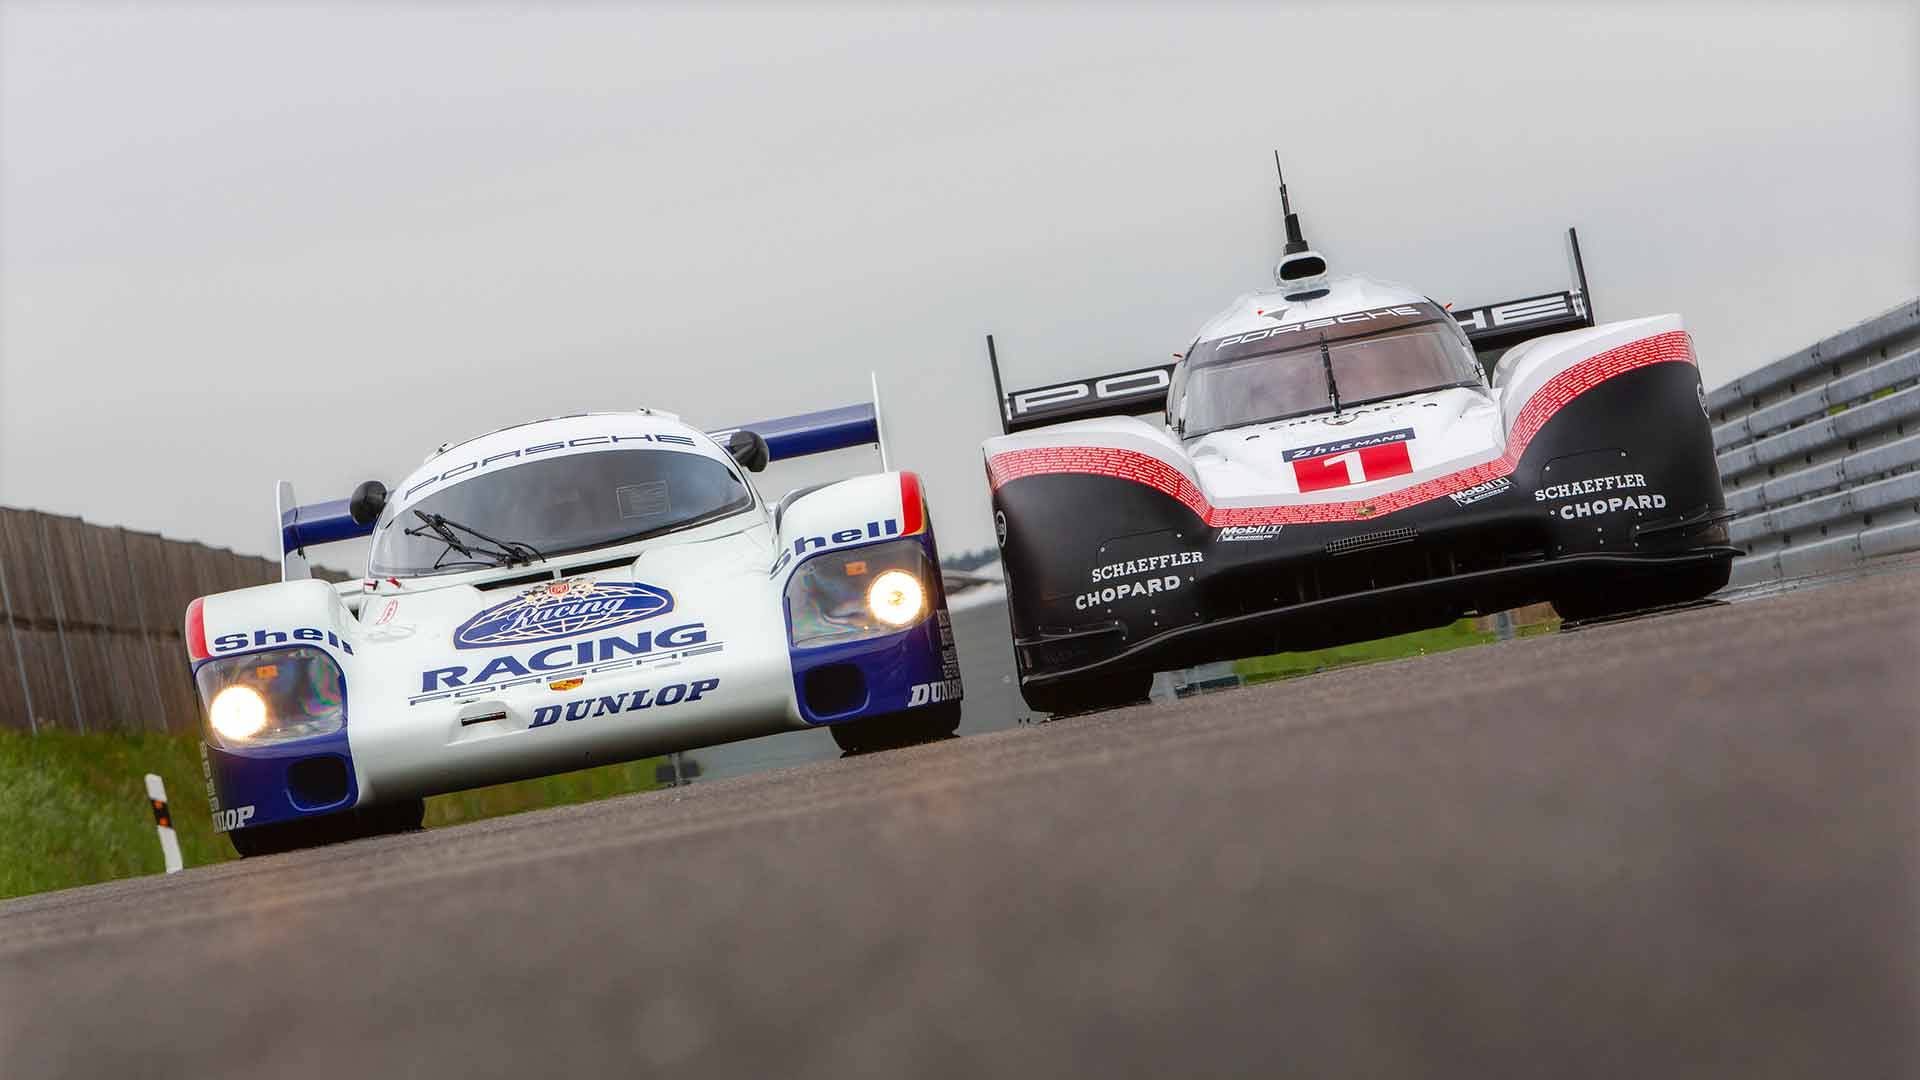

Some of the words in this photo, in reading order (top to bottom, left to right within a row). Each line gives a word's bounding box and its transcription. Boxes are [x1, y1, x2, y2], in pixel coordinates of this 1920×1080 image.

[1216, 306, 1421, 351] PORSCHE
[1355, 433, 1406, 448] MANS
[404, 434, 696, 500] PORSCHE
[1323, 450, 1366, 484] 1
[1535, 474, 1647, 502] SCHAEFFLER
[1560, 494, 1667, 520] CHOPARD
[769, 519, 897, 580] Shell
[1092, 551, 1204, 583] SCHAEFFLER
[1075, 575, 1181, 610] CHOPARD
[499, 598, 626, 632] Racing
[214, 628, 354, 656] Shell
[422, 623, 709, 692] RACING
[528, 678, 720, 729] DUNLOP
